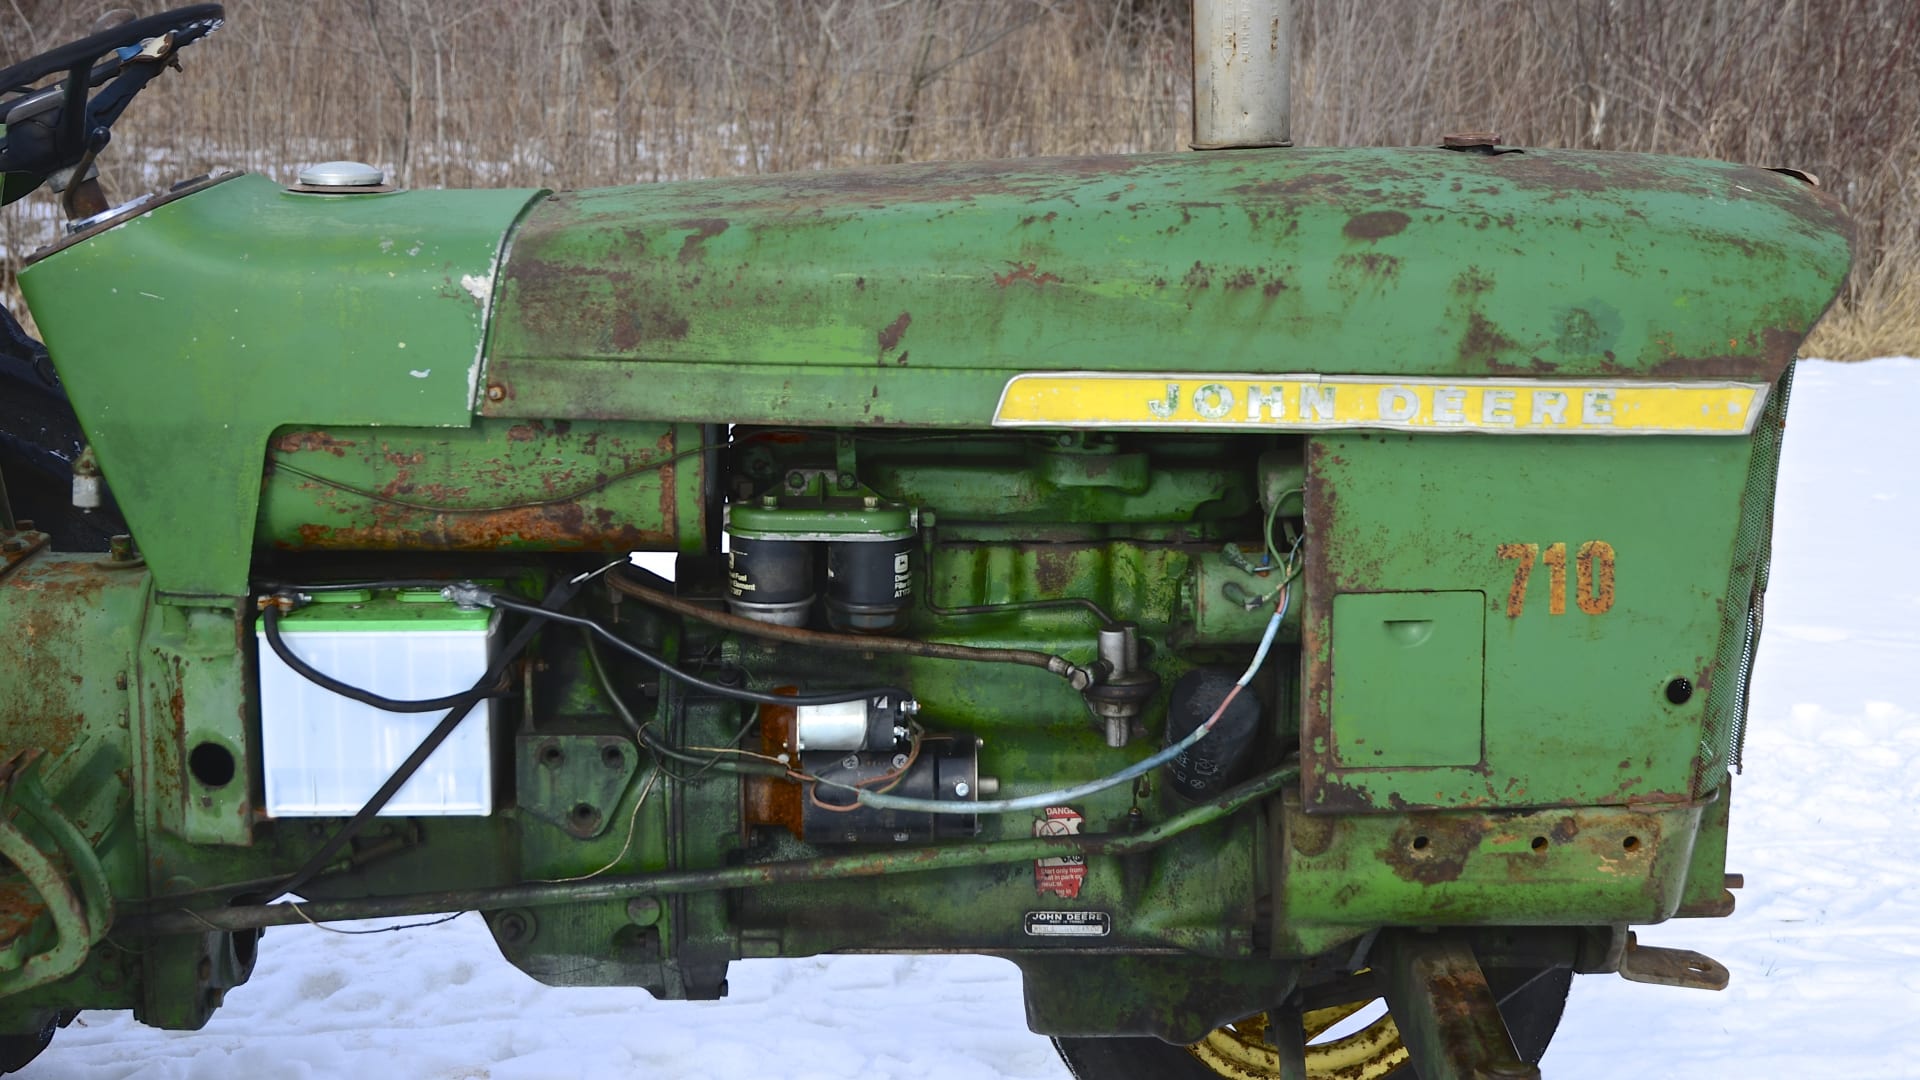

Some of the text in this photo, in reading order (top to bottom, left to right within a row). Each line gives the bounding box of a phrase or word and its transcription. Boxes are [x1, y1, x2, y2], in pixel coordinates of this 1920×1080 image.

[1148, 383, 1616, 425] JOHN DEERE
[1496, 541, 1615, 618] 710
[1032, 913, 1103, 921] JOHN DEERE
